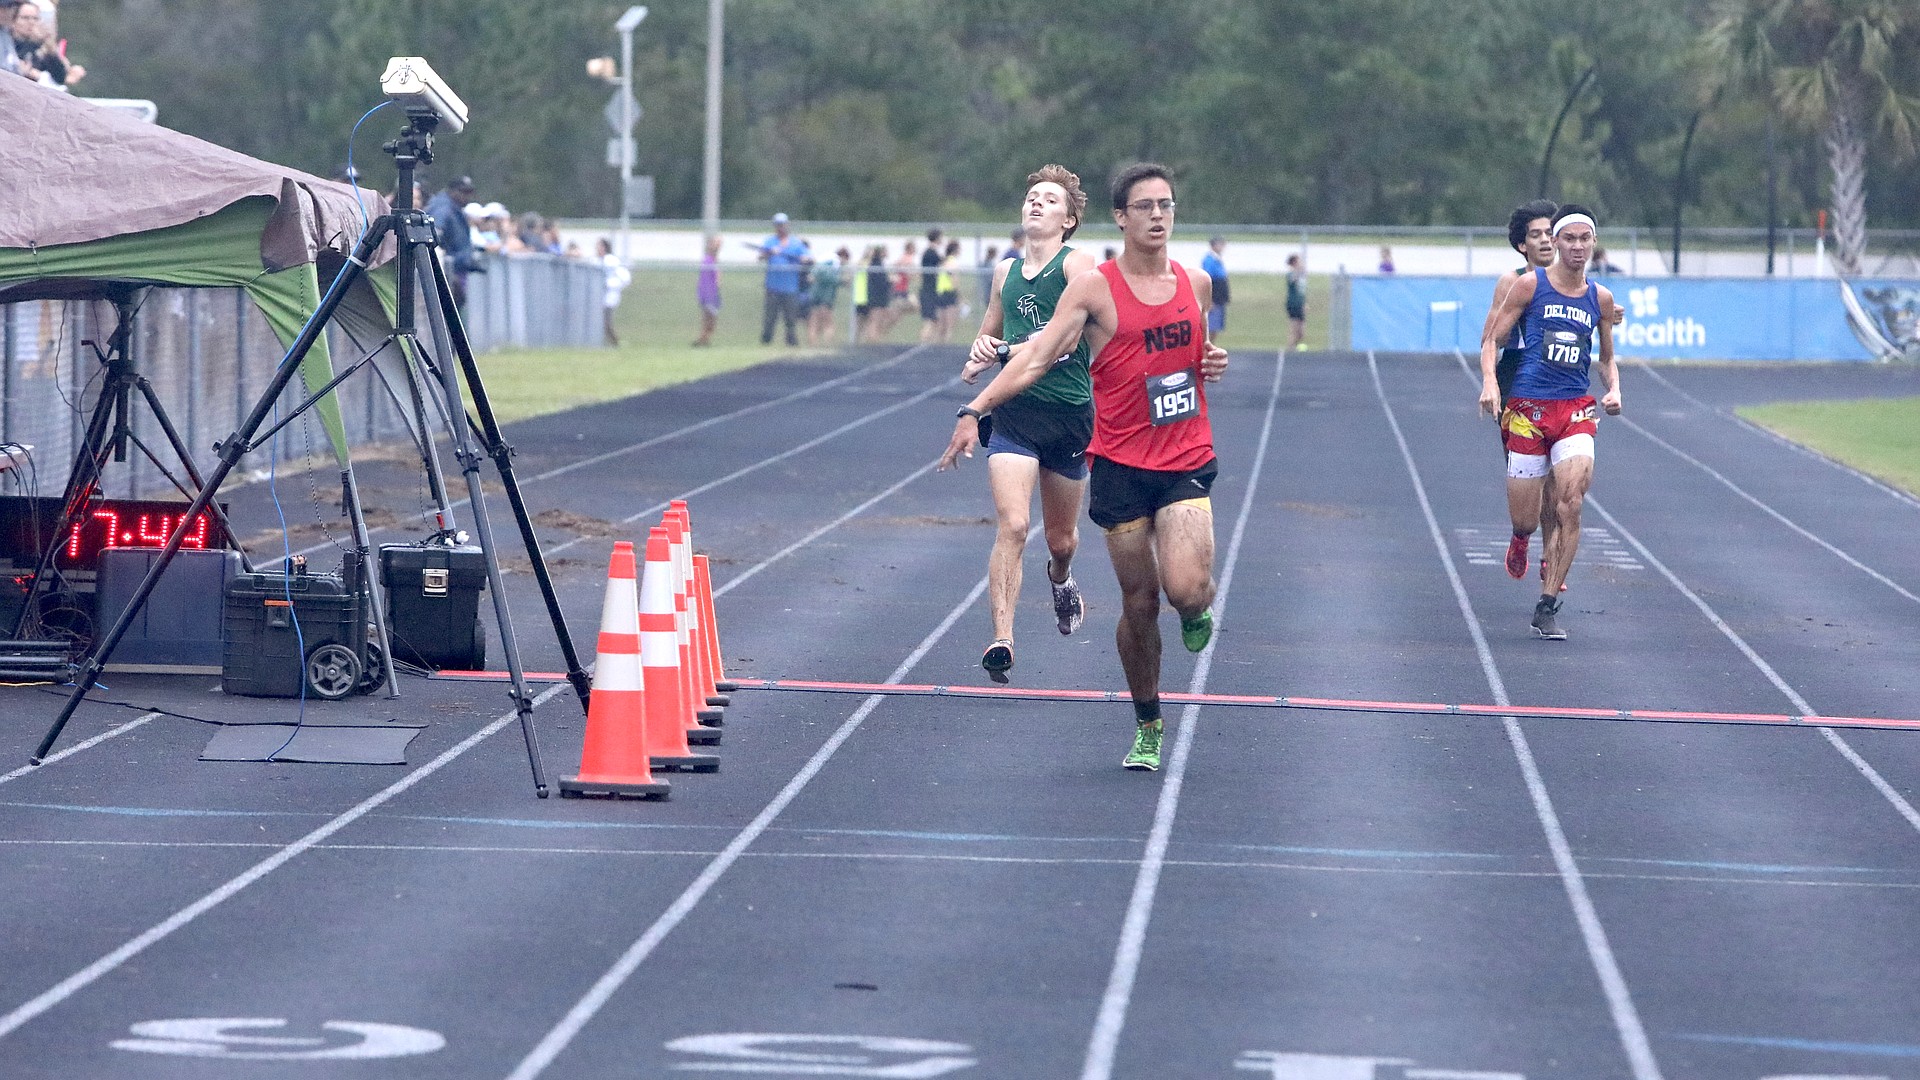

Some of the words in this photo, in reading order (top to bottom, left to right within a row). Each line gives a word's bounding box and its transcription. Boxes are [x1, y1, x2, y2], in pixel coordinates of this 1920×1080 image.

[1543, 304, 1592, 328] DELTONA
[1143, 320, 1192, 354] NSB
[1547, 343, 1580, 364] 1718
[1153, 386, 1196, 419] 1957
